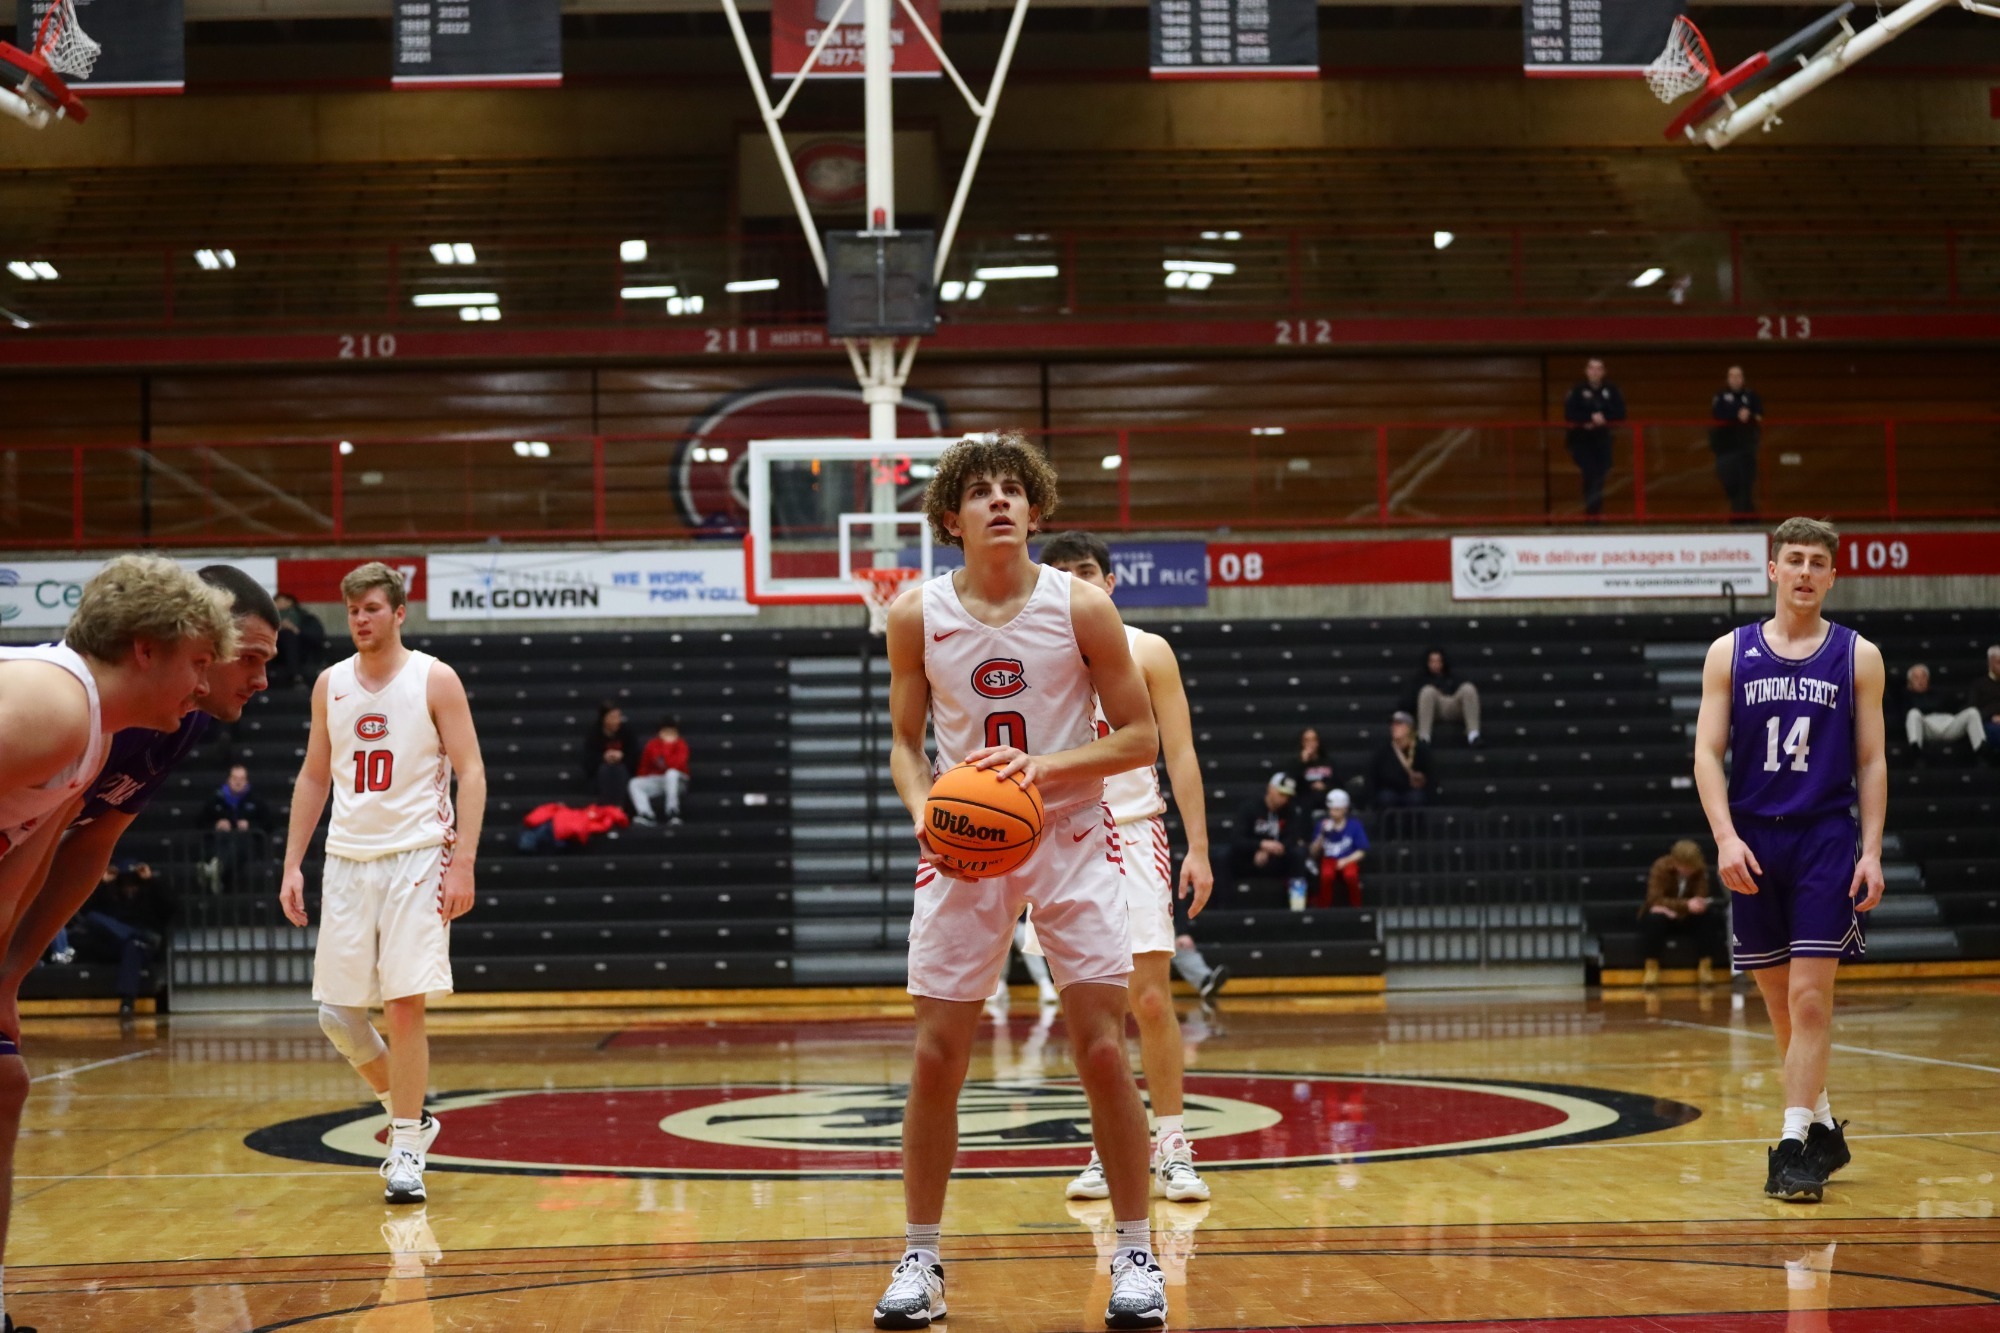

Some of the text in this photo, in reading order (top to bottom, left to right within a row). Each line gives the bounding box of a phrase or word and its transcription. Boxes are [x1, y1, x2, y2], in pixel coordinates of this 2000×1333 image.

[1275, 320, 1331, 344] 212
[1757, 315, 1811, 339] 213
[338, 334, 396, 358] 210
[704, 329, 758, 352] 211
[1517, 551, 1540, 564] We
[1545, 550, 1597, 564] deliver
[1602, 549, 1675, 567] packages
[1680, 549, 1695, 563] to
[1848, 541, 1909, 570] 109
[612, 571, 704, 585] WE WORK
[35, 580, 84, 609] Ce
[452, 586, 599, 609] McGOWAN
[650, 588, 688, 600] FOR
[1744, 677, 1839, 710] WINONA STATE
[1763, 716, 1811, 772] 14
[353, 750, 393, 793] 10
[933, 806, 1006, 843] Wilson
